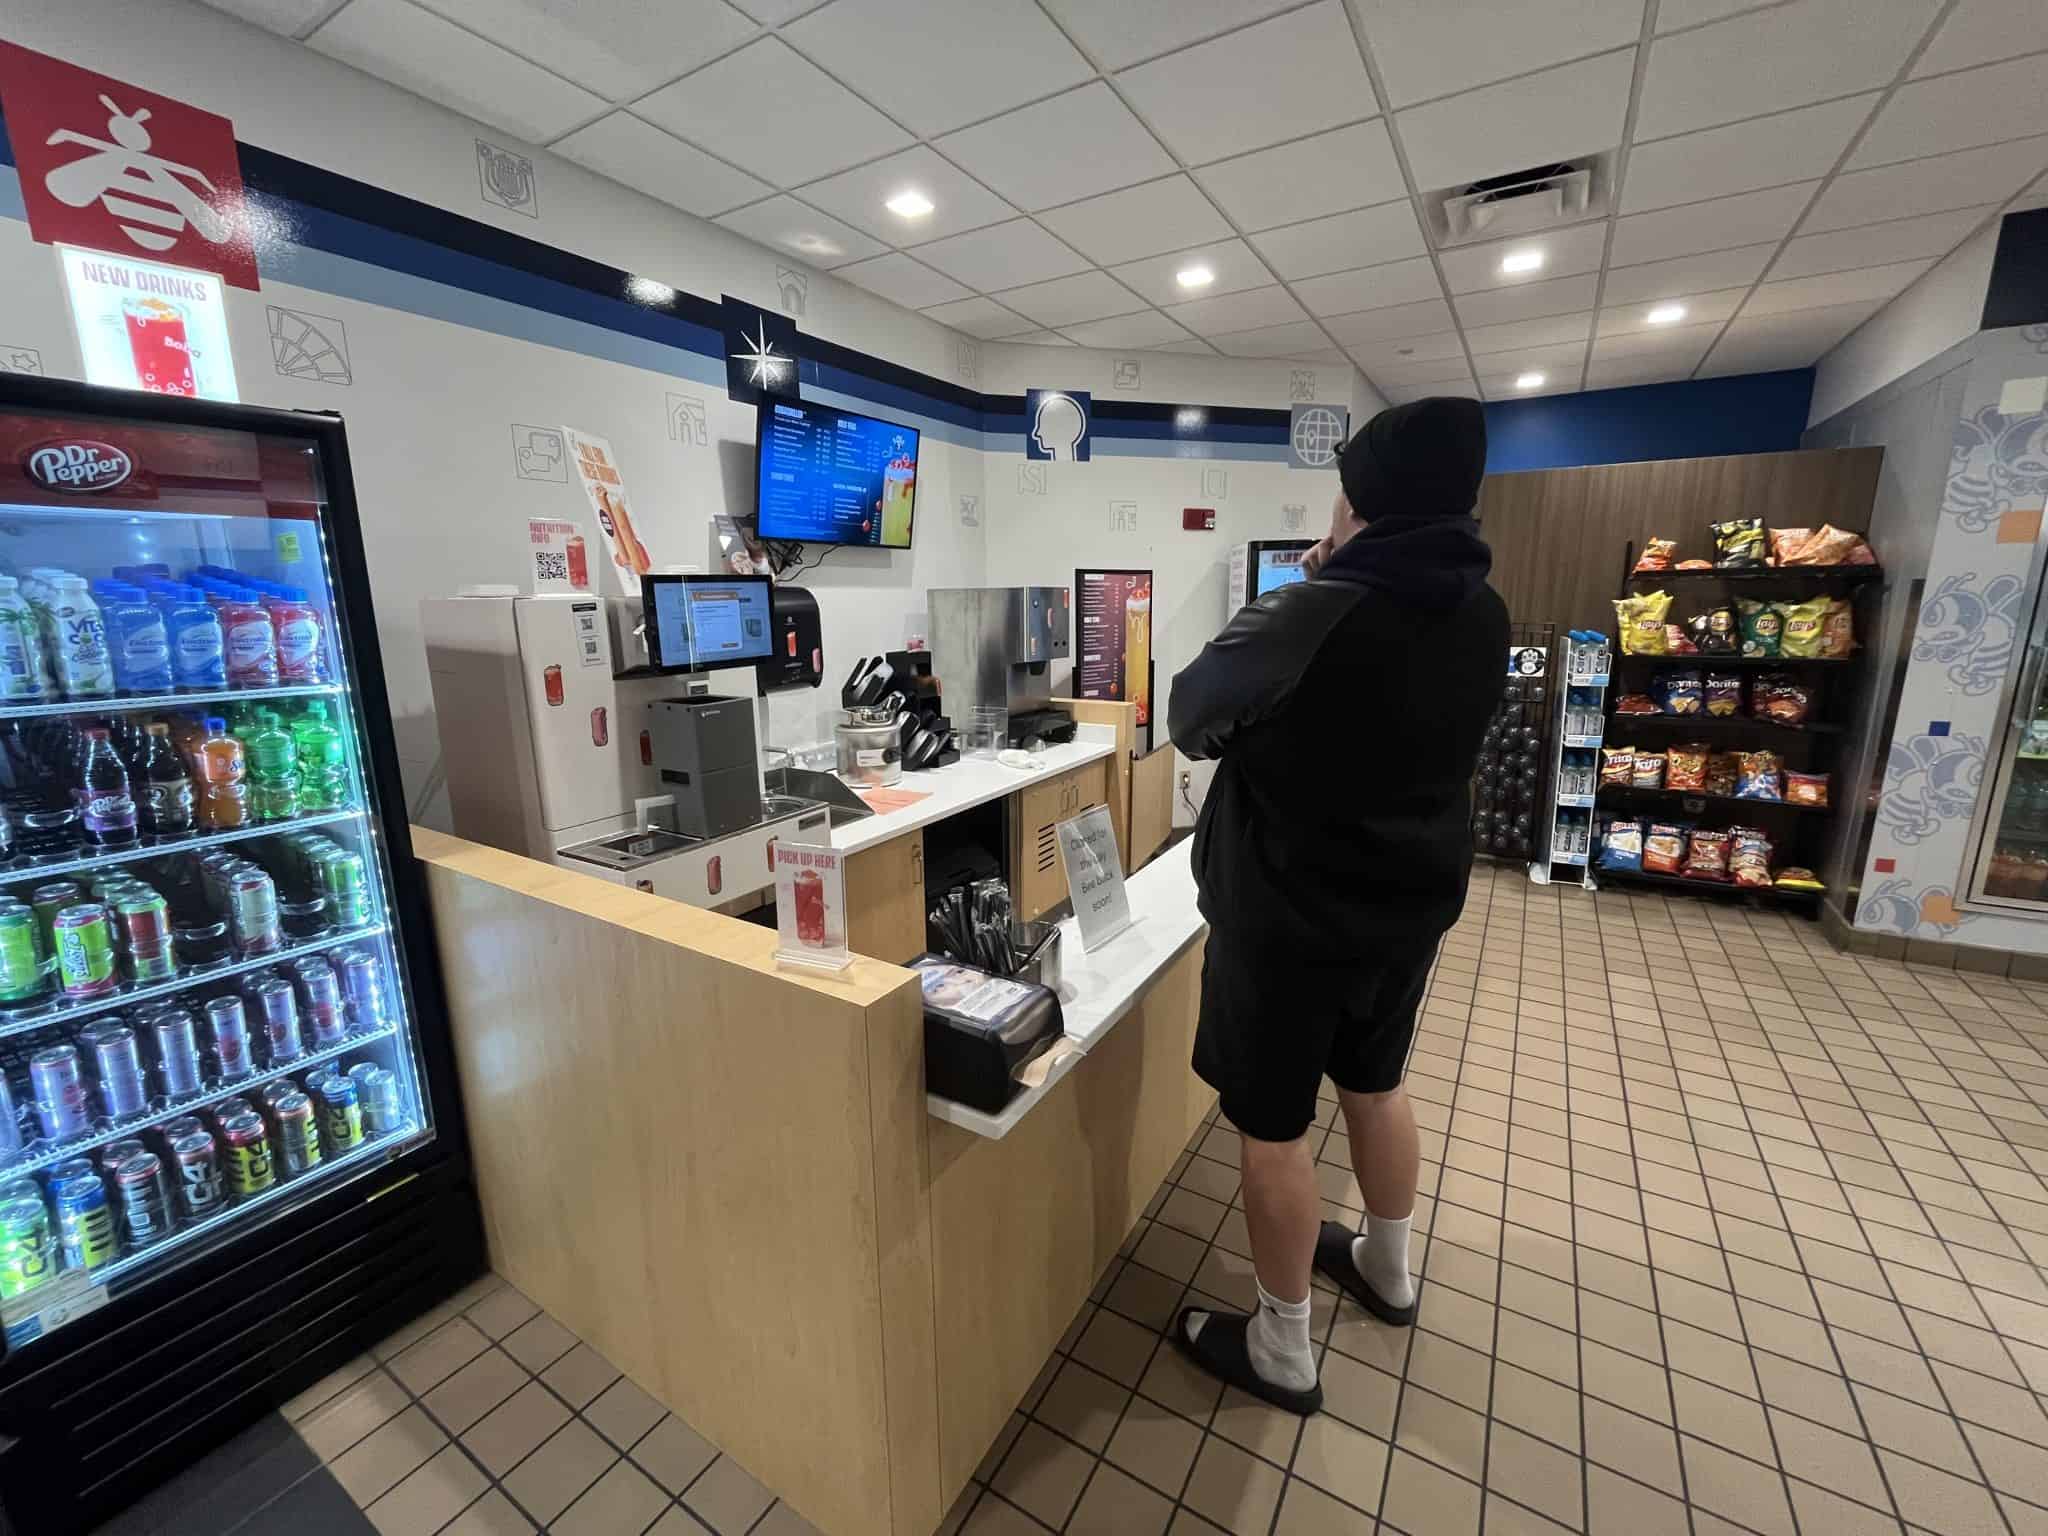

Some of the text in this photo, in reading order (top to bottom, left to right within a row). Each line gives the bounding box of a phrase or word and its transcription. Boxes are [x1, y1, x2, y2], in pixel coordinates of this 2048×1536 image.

[82, 261, 208, 301] NEW DRINKS
[31, 448, 123, 485] Pepper
[63, 445, 99, 466] Dr
[777, 848, 836, 870] PICK UP HERE
